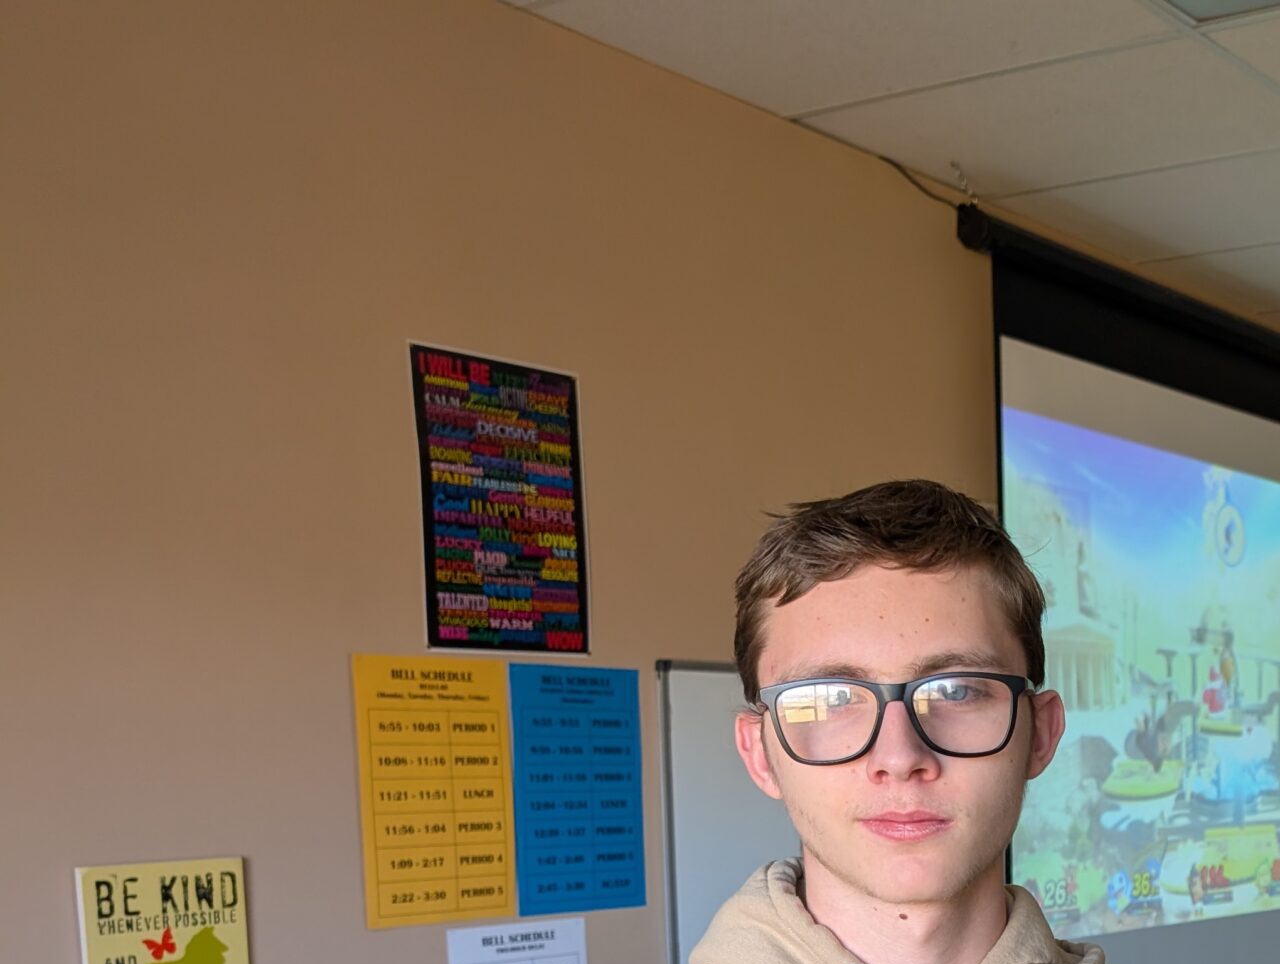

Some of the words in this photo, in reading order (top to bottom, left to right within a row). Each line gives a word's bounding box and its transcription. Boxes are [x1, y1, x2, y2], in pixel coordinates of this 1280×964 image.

[428, 353, 467, 381] WILL
[469, 359, 491, 386] BE
[477, 421, 539, 443] DECISIVE
[471, 499, 521, 518] HAPPY
[523, 507, 574, 525] HELPFUL
[435, 537, 482, 549] LUCKY
[538, 533, 577, 549] LOVING
[437, 592, 488, 611] TALENTED
[490, 618, 533, 630] WARM
[546, 631, 583, 649] WOW
[391, 668, 416, 681] BELL
[420, 670, 473, 683] SCHEDULE
[452, 723, 488, 733] PERIOD
[454, 756, 489, 766] PERIOD
[379, 790, 408, 802] 11:21
[419, 790, 448, 800] 11:51
[463, 789, 494, 799] LUNCH
[458, 822, 493, 832] PERIOD
[422, 857, 445, 868] 2:17
[459, 855, 494, 865] PERIOD
[95, 877, 140, 919] BE
[160, 872, 238, 914] KIND
[461, 887, 495, 898] PERIOD
[98, 914, 169, 935] WHENEVER
[174, 909, 237, 928] POSSIBLE
[481, 935, 504, 947] BELL
[508, 930, 556, 944] SCHEDULE
